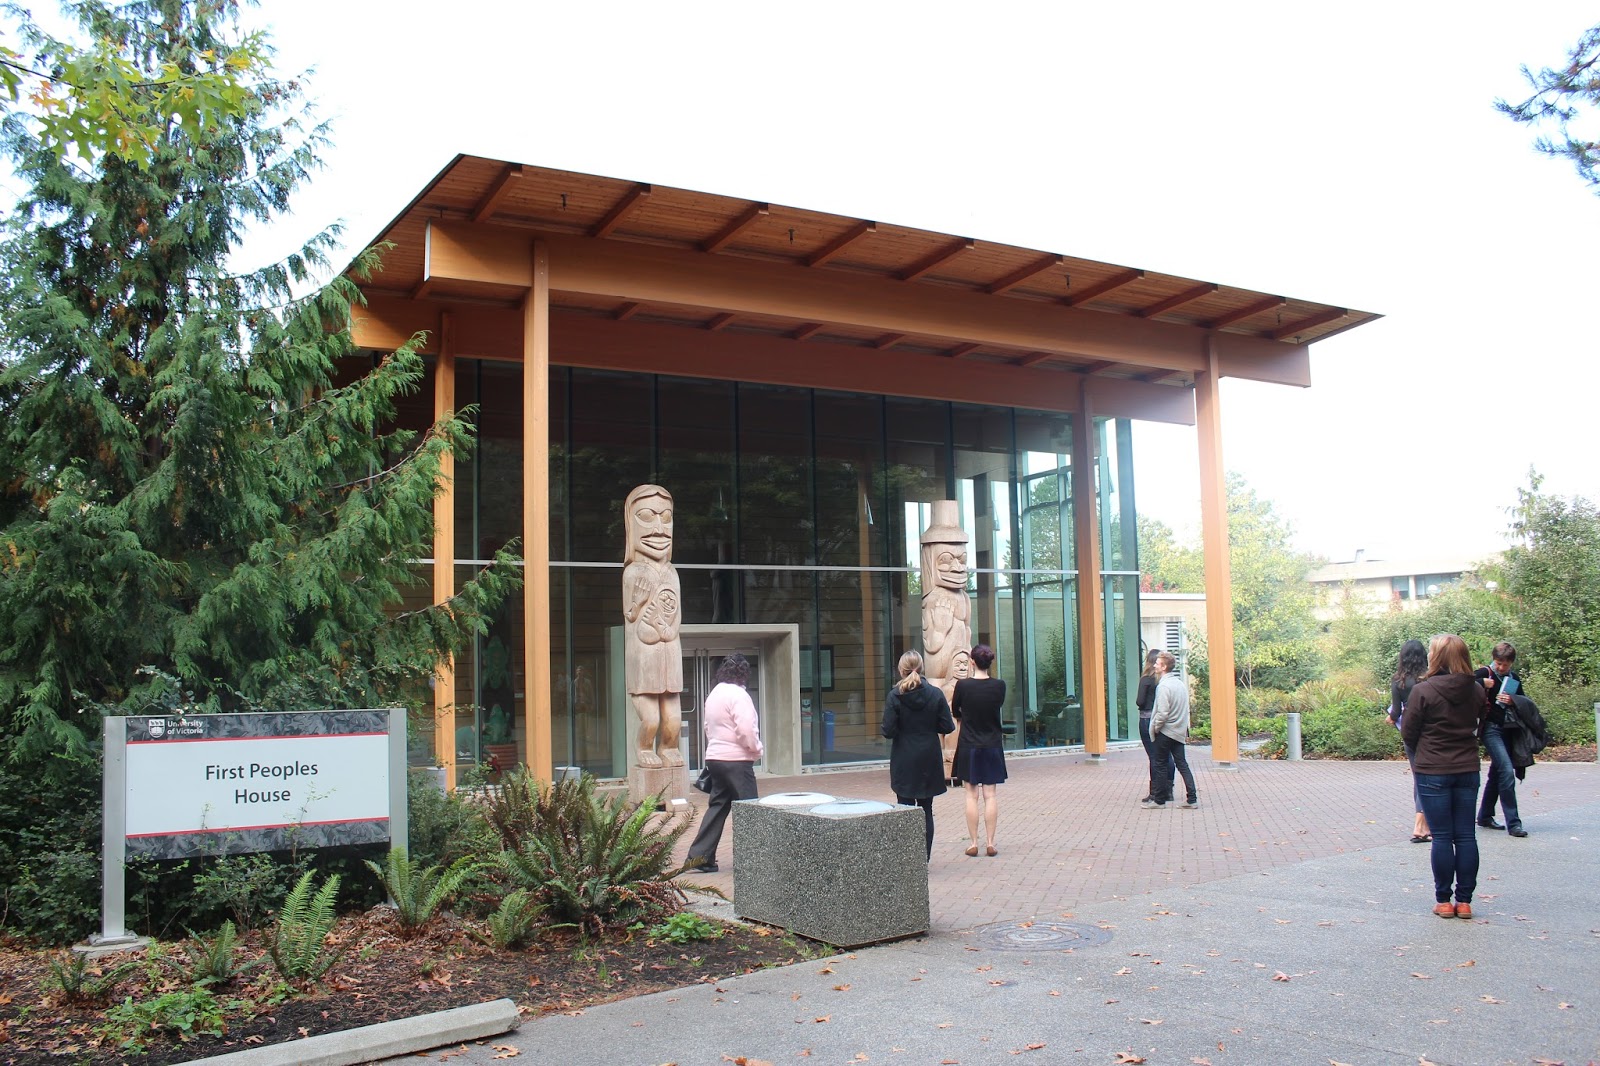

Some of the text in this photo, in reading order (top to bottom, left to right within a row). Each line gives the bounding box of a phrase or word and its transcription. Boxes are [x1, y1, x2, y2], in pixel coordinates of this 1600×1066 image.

[167, 719, 204, 728] Unrsity
[167, 726, 204, 735] of Victoria
[205, 760, 319, 781] First Peoples
[235, 788, 291, 804] House
